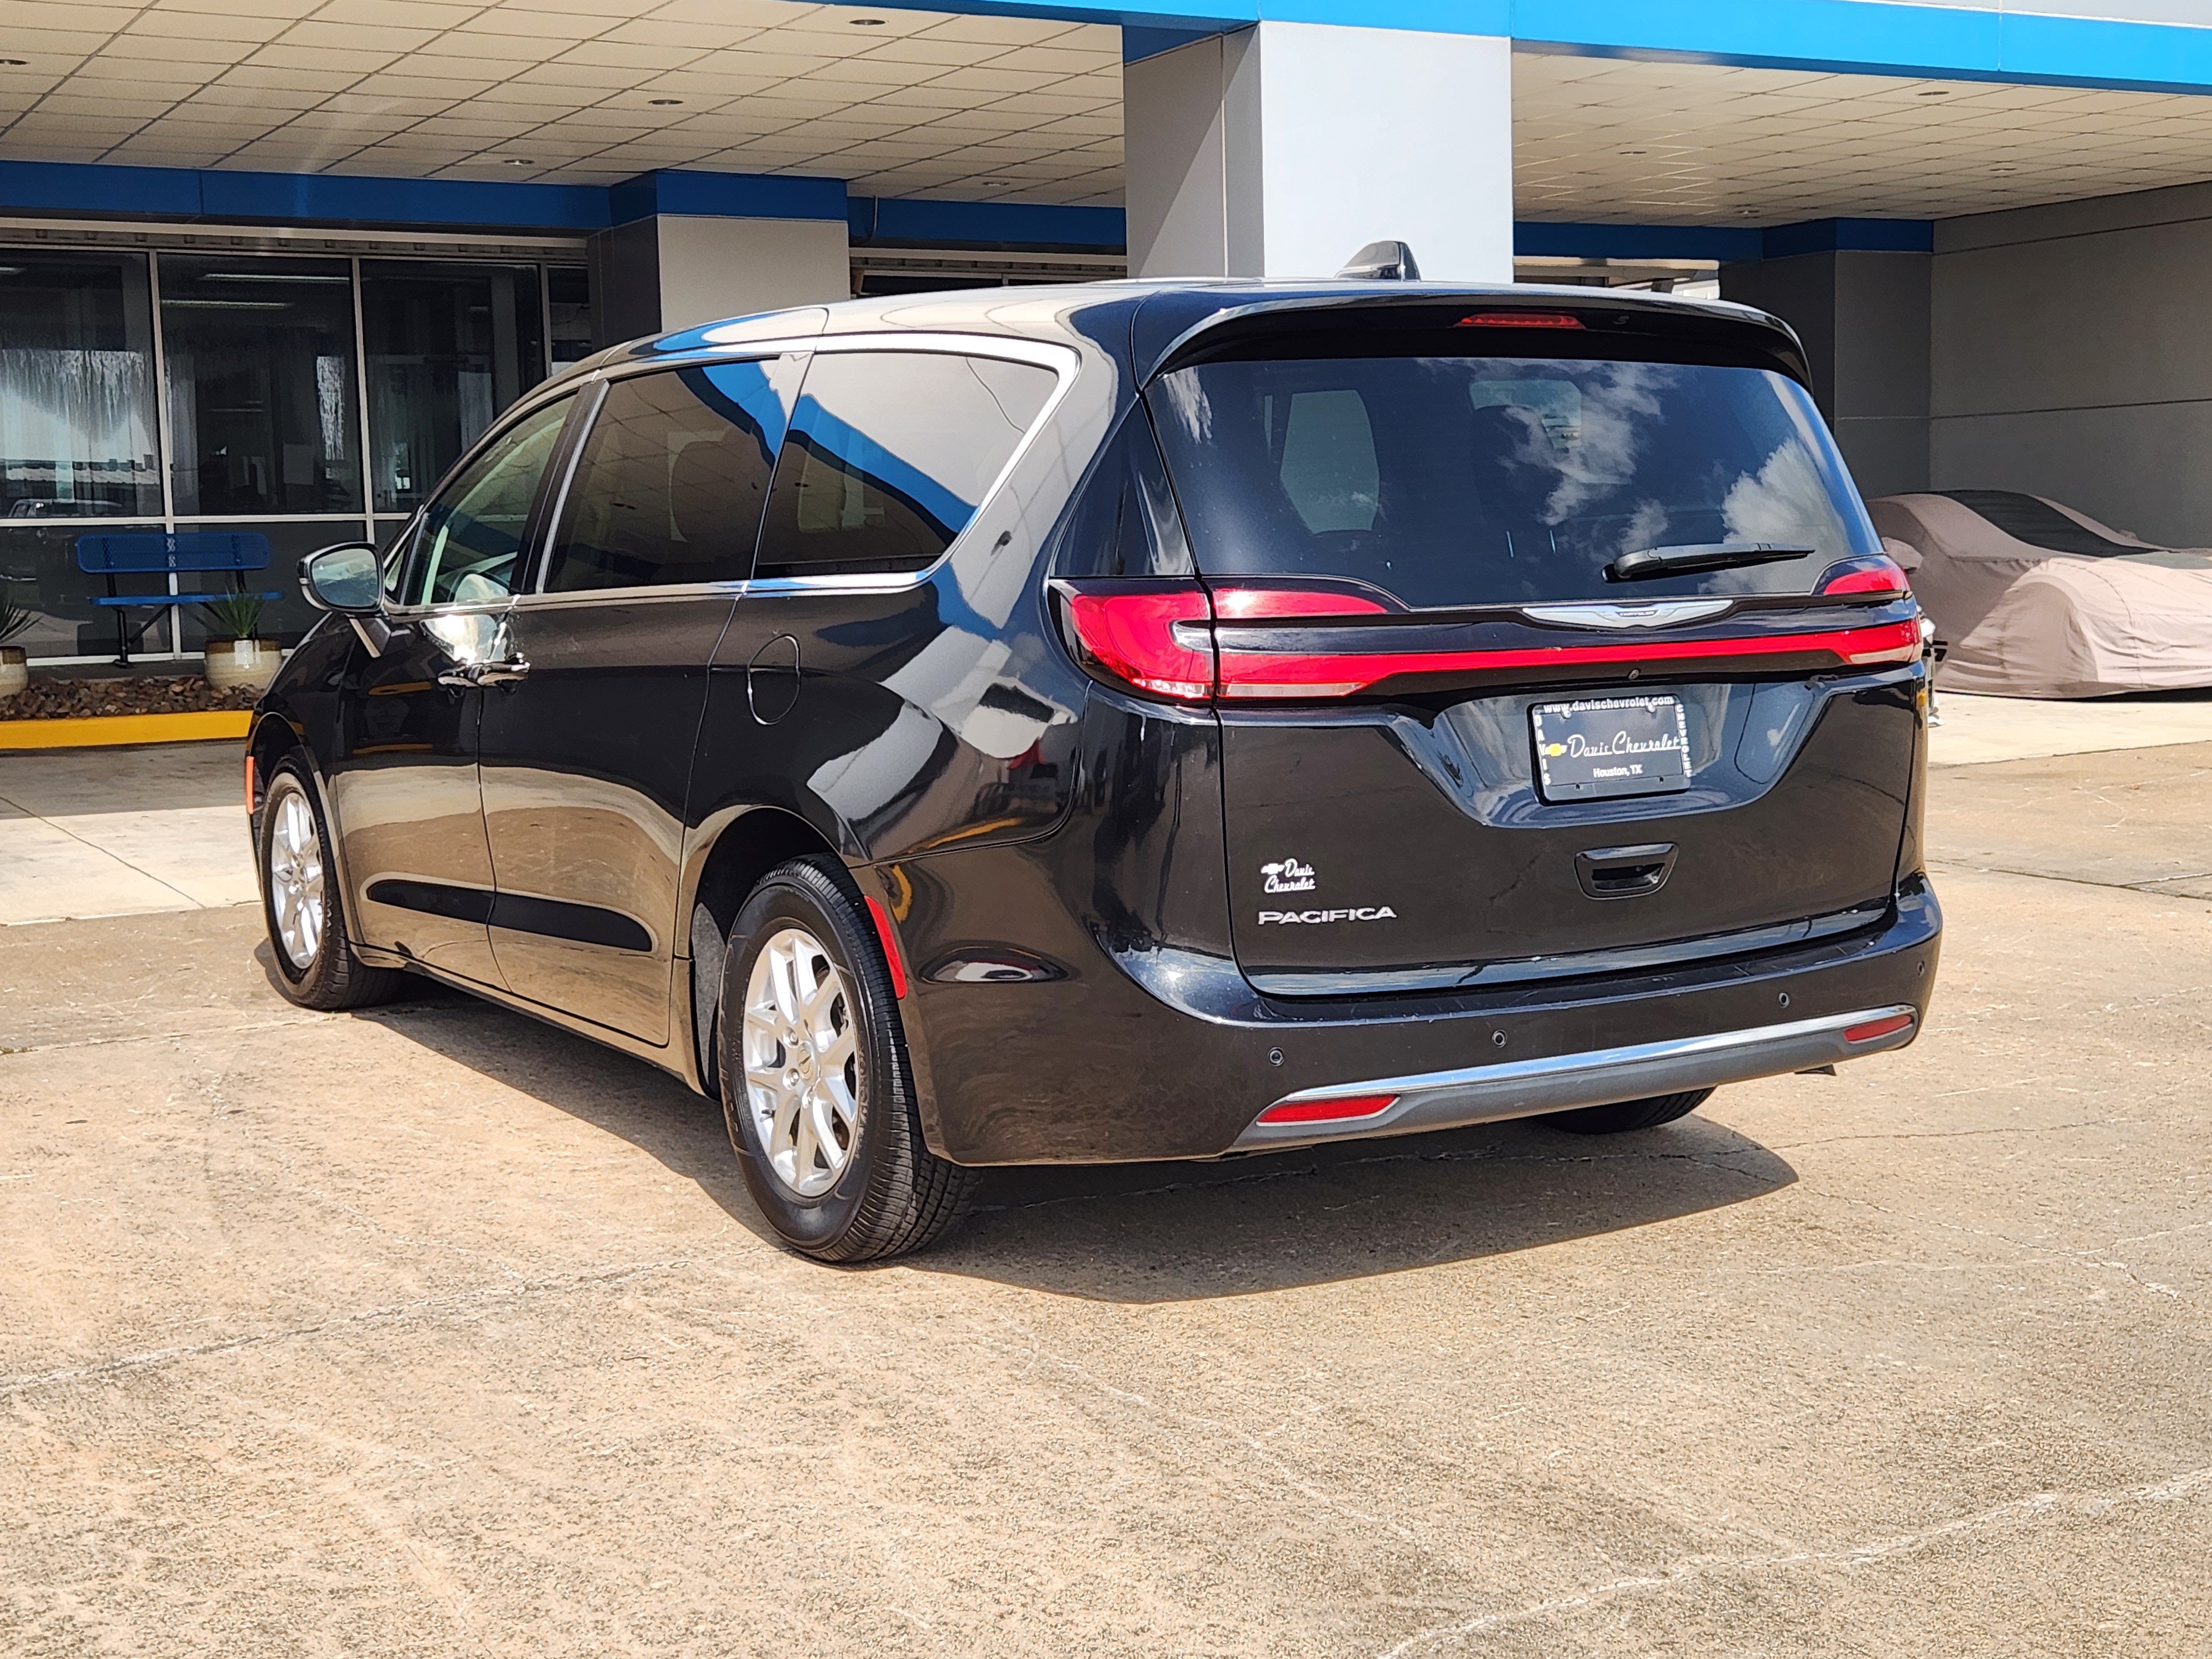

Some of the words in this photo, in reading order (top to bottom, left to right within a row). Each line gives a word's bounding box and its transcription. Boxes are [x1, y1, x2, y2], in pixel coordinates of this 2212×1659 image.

[1543, 696, 1674, 713] www.davischevrolet.com
[1535, 714, 1551, 785] DAVIS
[1567, 734, 1613, 758] Davis
[1612, 731, 1681, 754] Chevrolet
[1676, 703, 1692, 778] CHEVROLET
[1593, 766, 1630, 779] Houston,
[1630, 764, 1643, 774] TX
[1285, 858, 1315, 878] Davis
[1264, 875, 1316, 894] Chevrolet
[1258, 906, 1397, 925] PACIFICA
